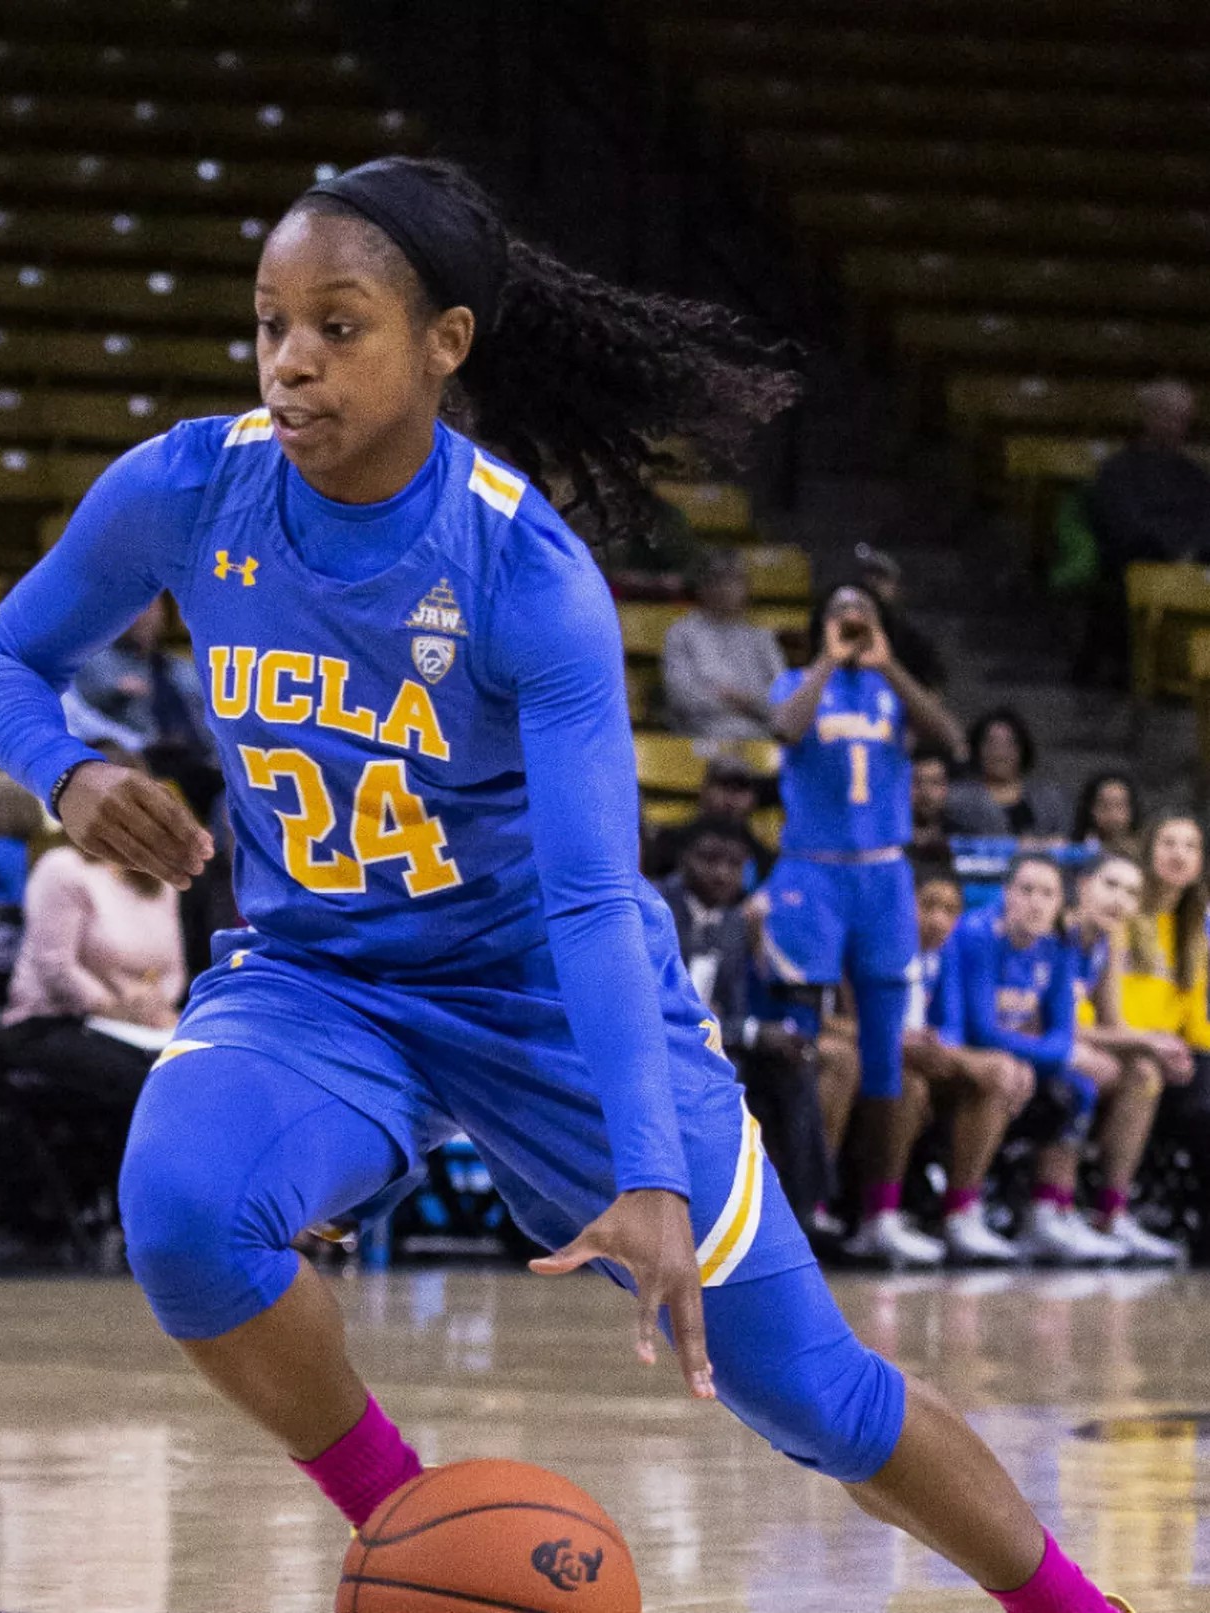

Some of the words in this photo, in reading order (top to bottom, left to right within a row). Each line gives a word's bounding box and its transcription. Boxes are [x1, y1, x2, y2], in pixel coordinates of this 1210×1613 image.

[208, 646, 450, 762] UCLA
[237, 744, 464, 899] 24
[849, 744, 869, 804] 1
